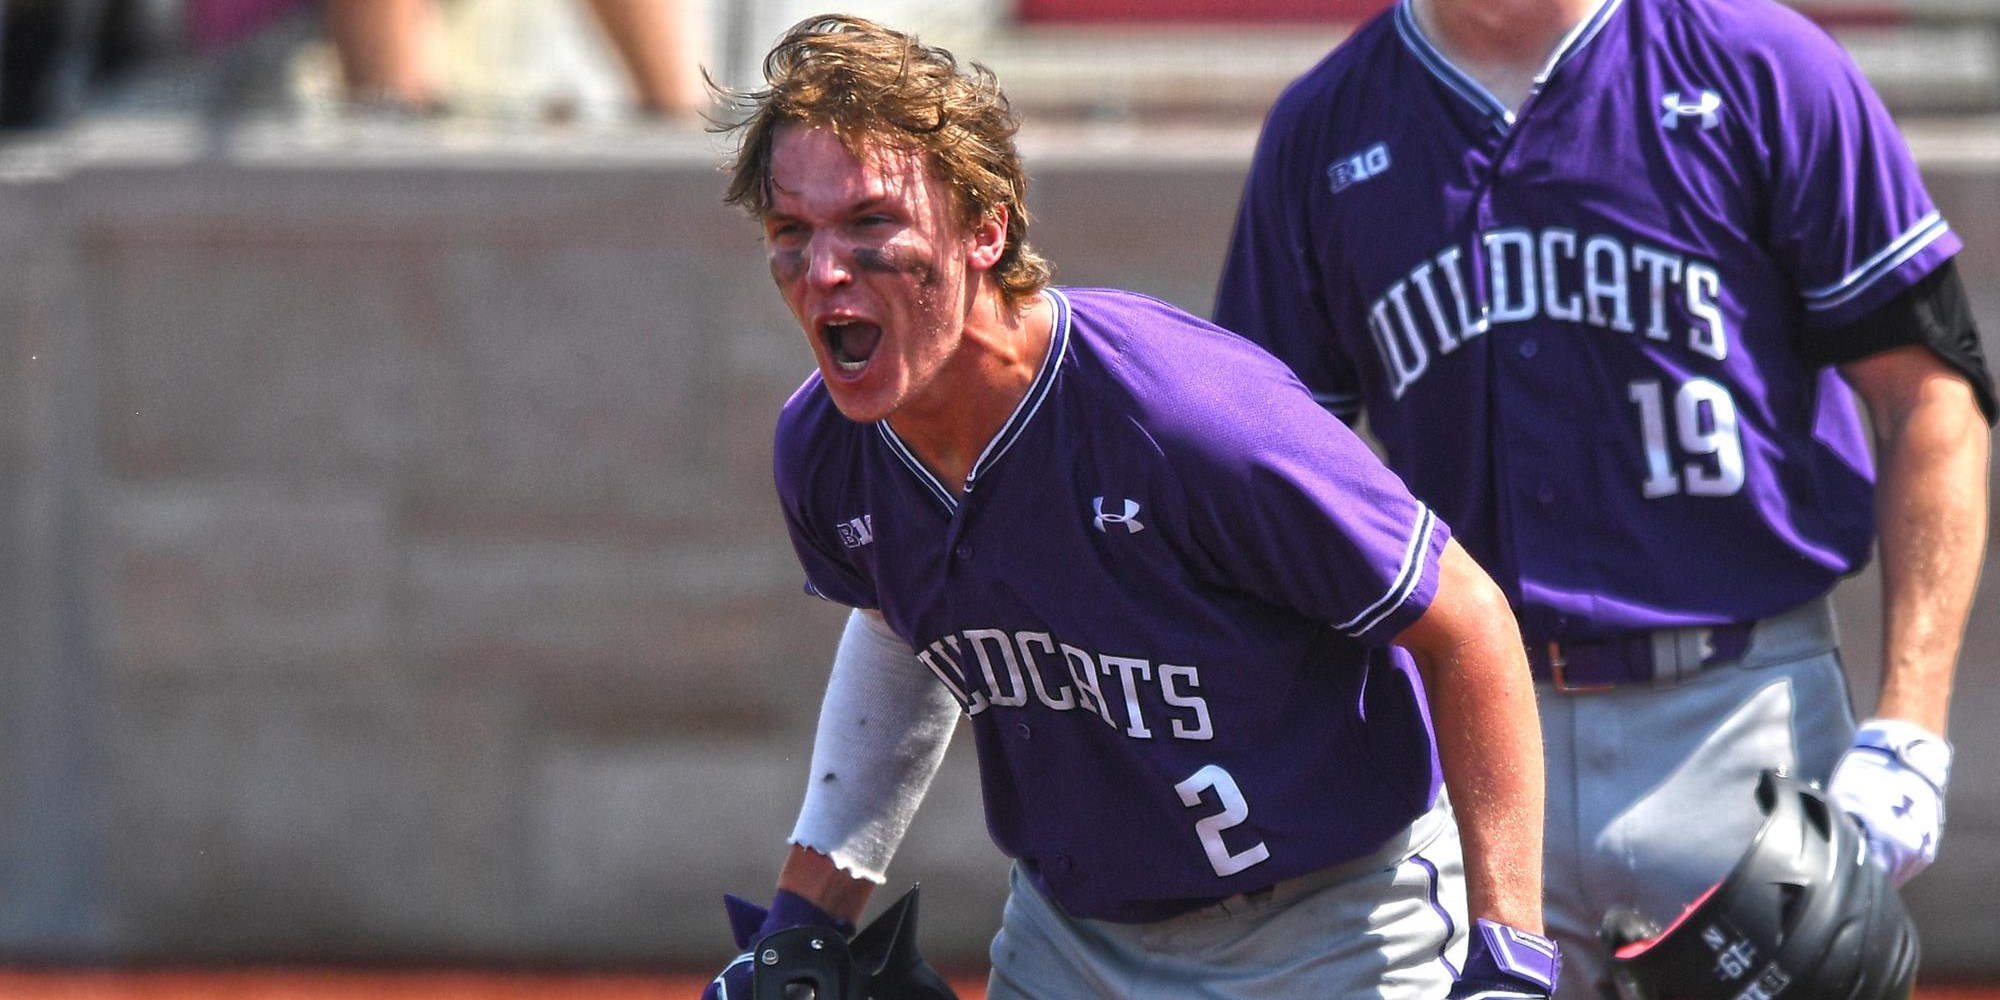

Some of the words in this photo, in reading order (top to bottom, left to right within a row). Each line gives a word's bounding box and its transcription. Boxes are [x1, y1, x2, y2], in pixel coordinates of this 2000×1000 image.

[1367, 228, 1727, 400] WILDCATS
[1629, 376, 1745, 499] 19
[1174, 764, 1270, 877] 2
